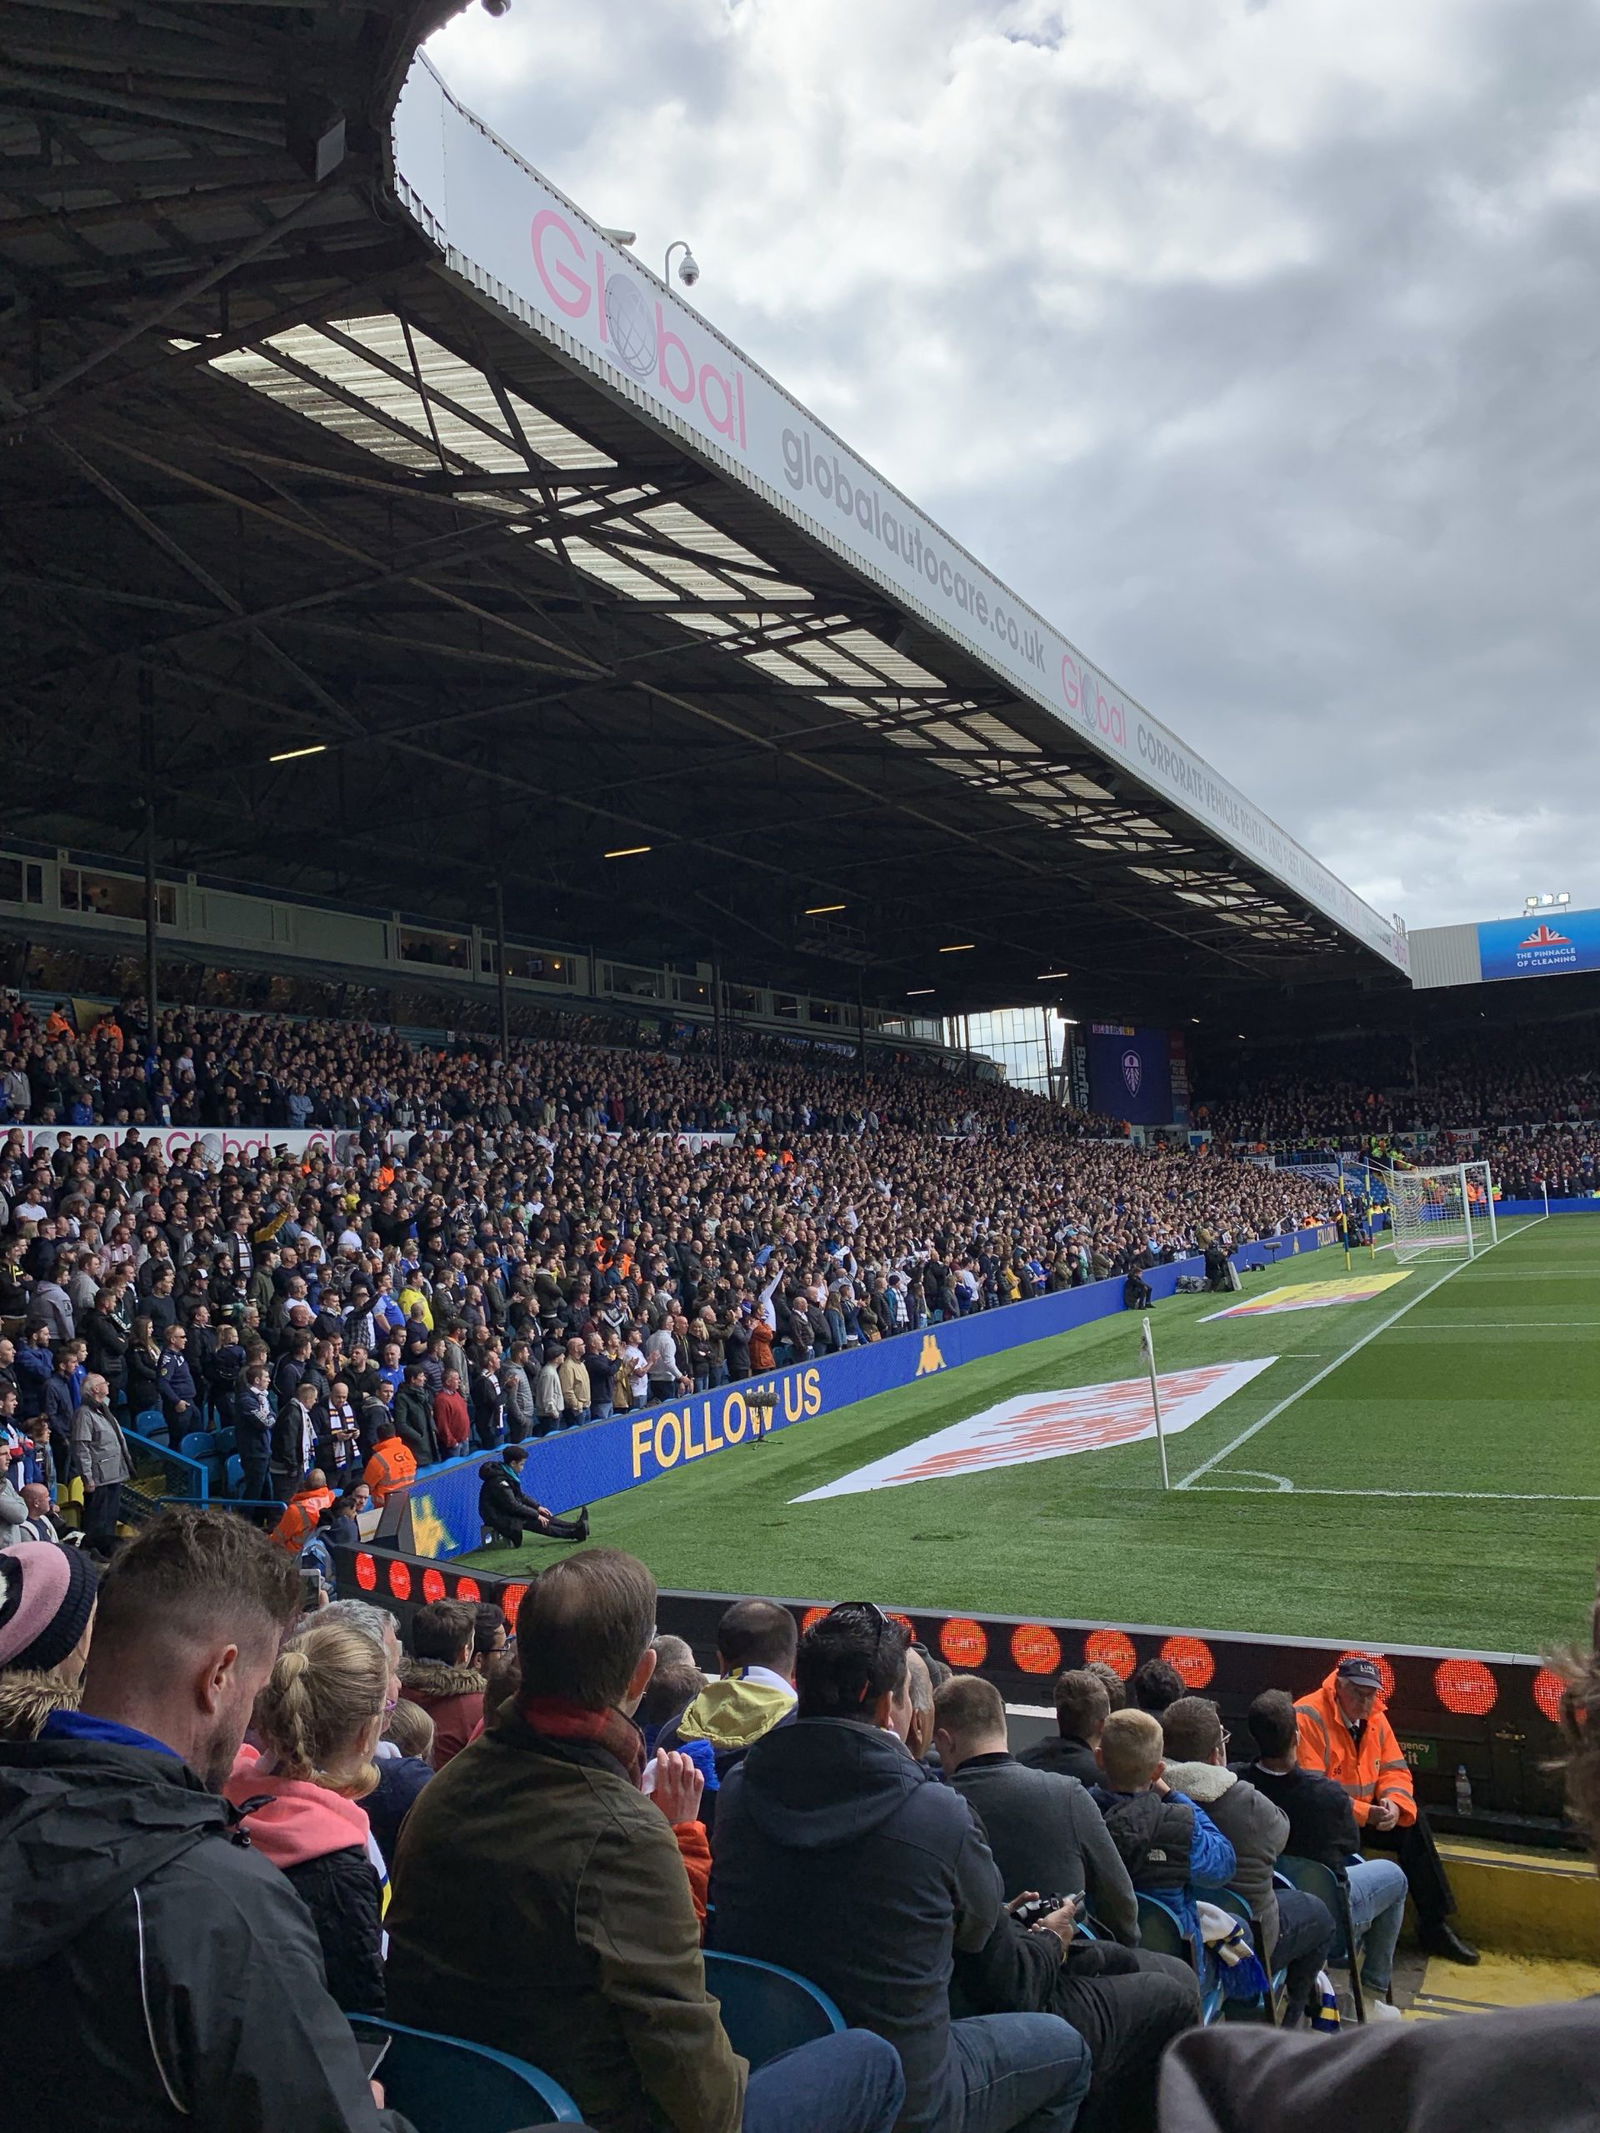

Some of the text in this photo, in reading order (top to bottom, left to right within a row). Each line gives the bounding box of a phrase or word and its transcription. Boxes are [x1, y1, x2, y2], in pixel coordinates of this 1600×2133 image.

[531, 209, 747, 450] Global
[782, 428, 1046, 673] globalautocare.co.uk
[1061, 654, 1127, 748] Global
[1137, 723, 1203, 802] CORPORATE
[1203, 778, 1239, 831] VEHICLE
[1516, 947, 1576, 960] THE PINNACLE
[1531, 955, 1577, 966] CLEANING
[631, 1368, 822, 1478] FOLLOW US
[1399, 1741, 1430, 1753] gency
